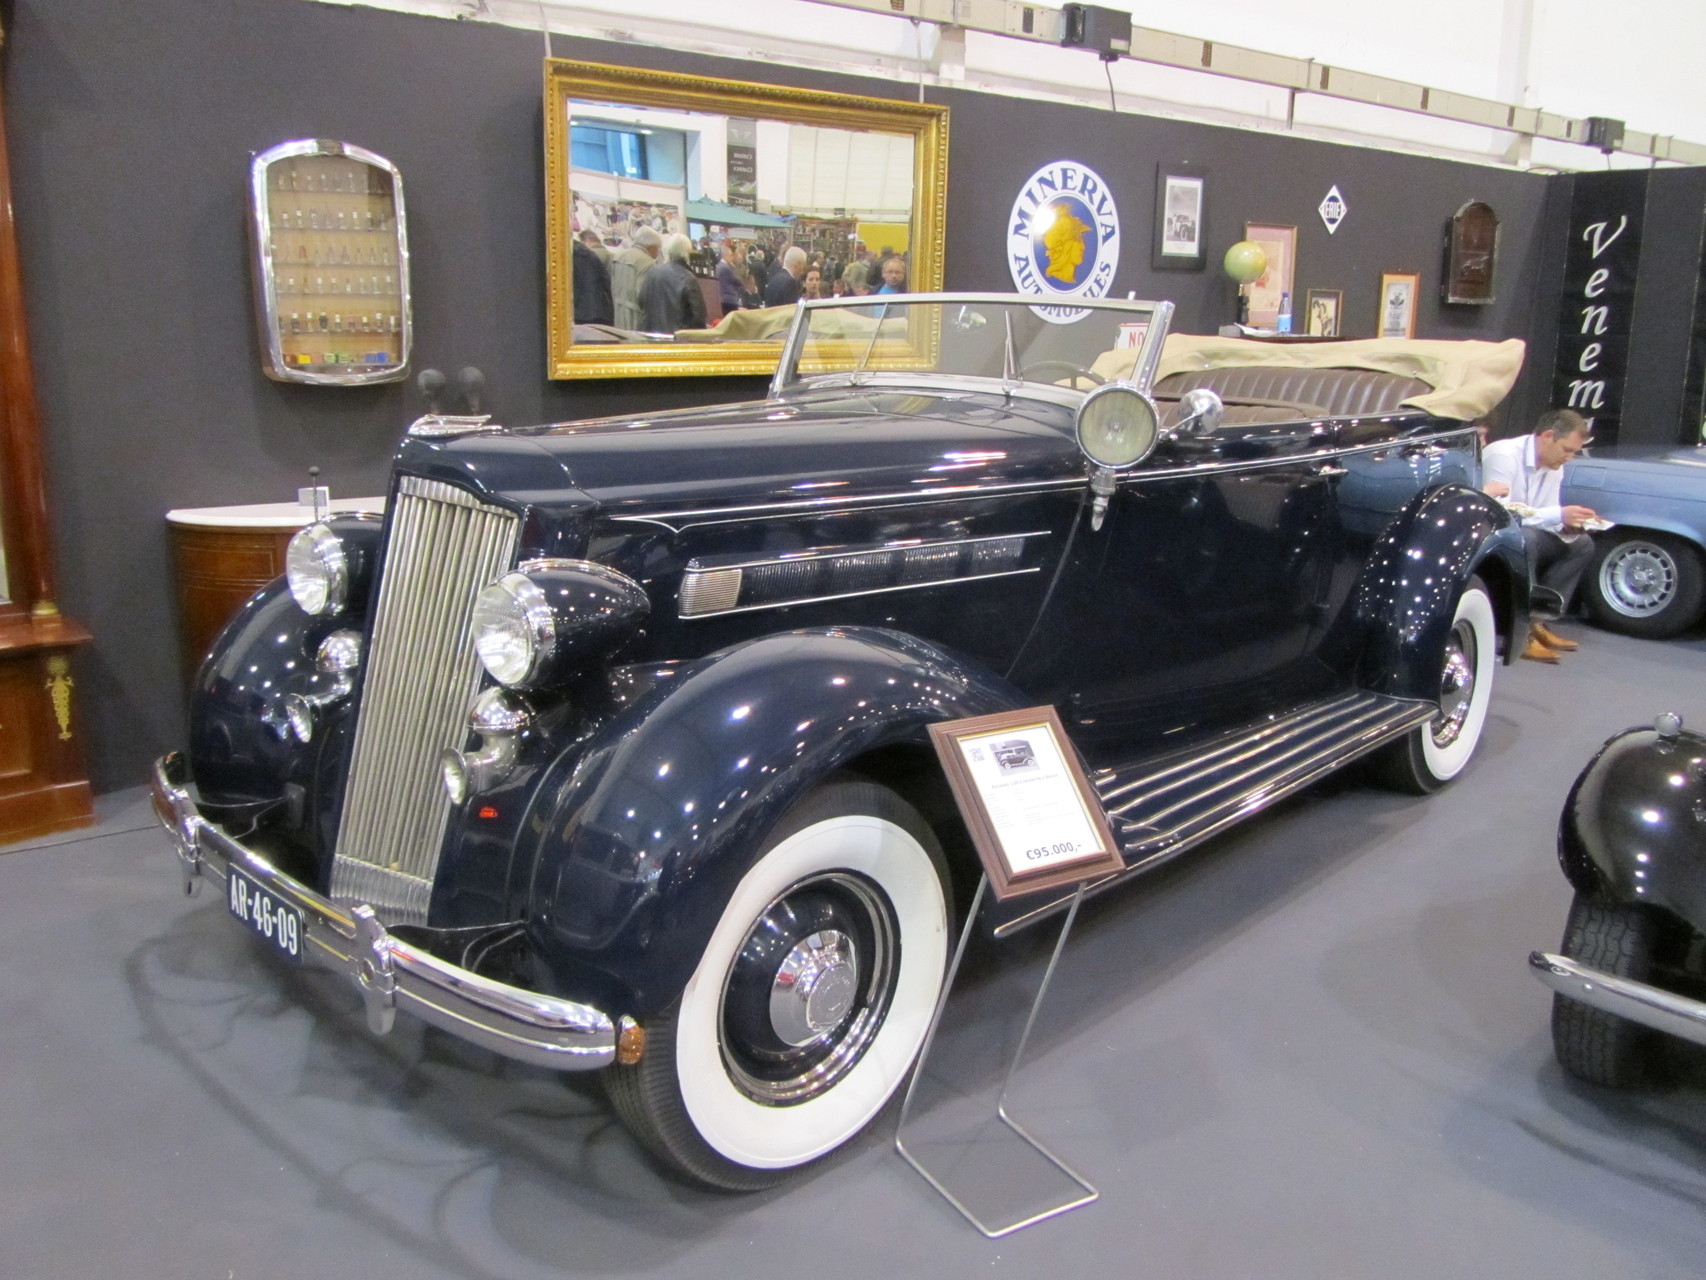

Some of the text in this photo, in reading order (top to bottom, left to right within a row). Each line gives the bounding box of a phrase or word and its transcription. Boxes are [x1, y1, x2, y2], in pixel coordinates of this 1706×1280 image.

[1012, 167, 1116, 246] MINERVA
[1013, 253, 1112, 318] AUTMOLES
[230, 874, 298, 955] AR-46-09
